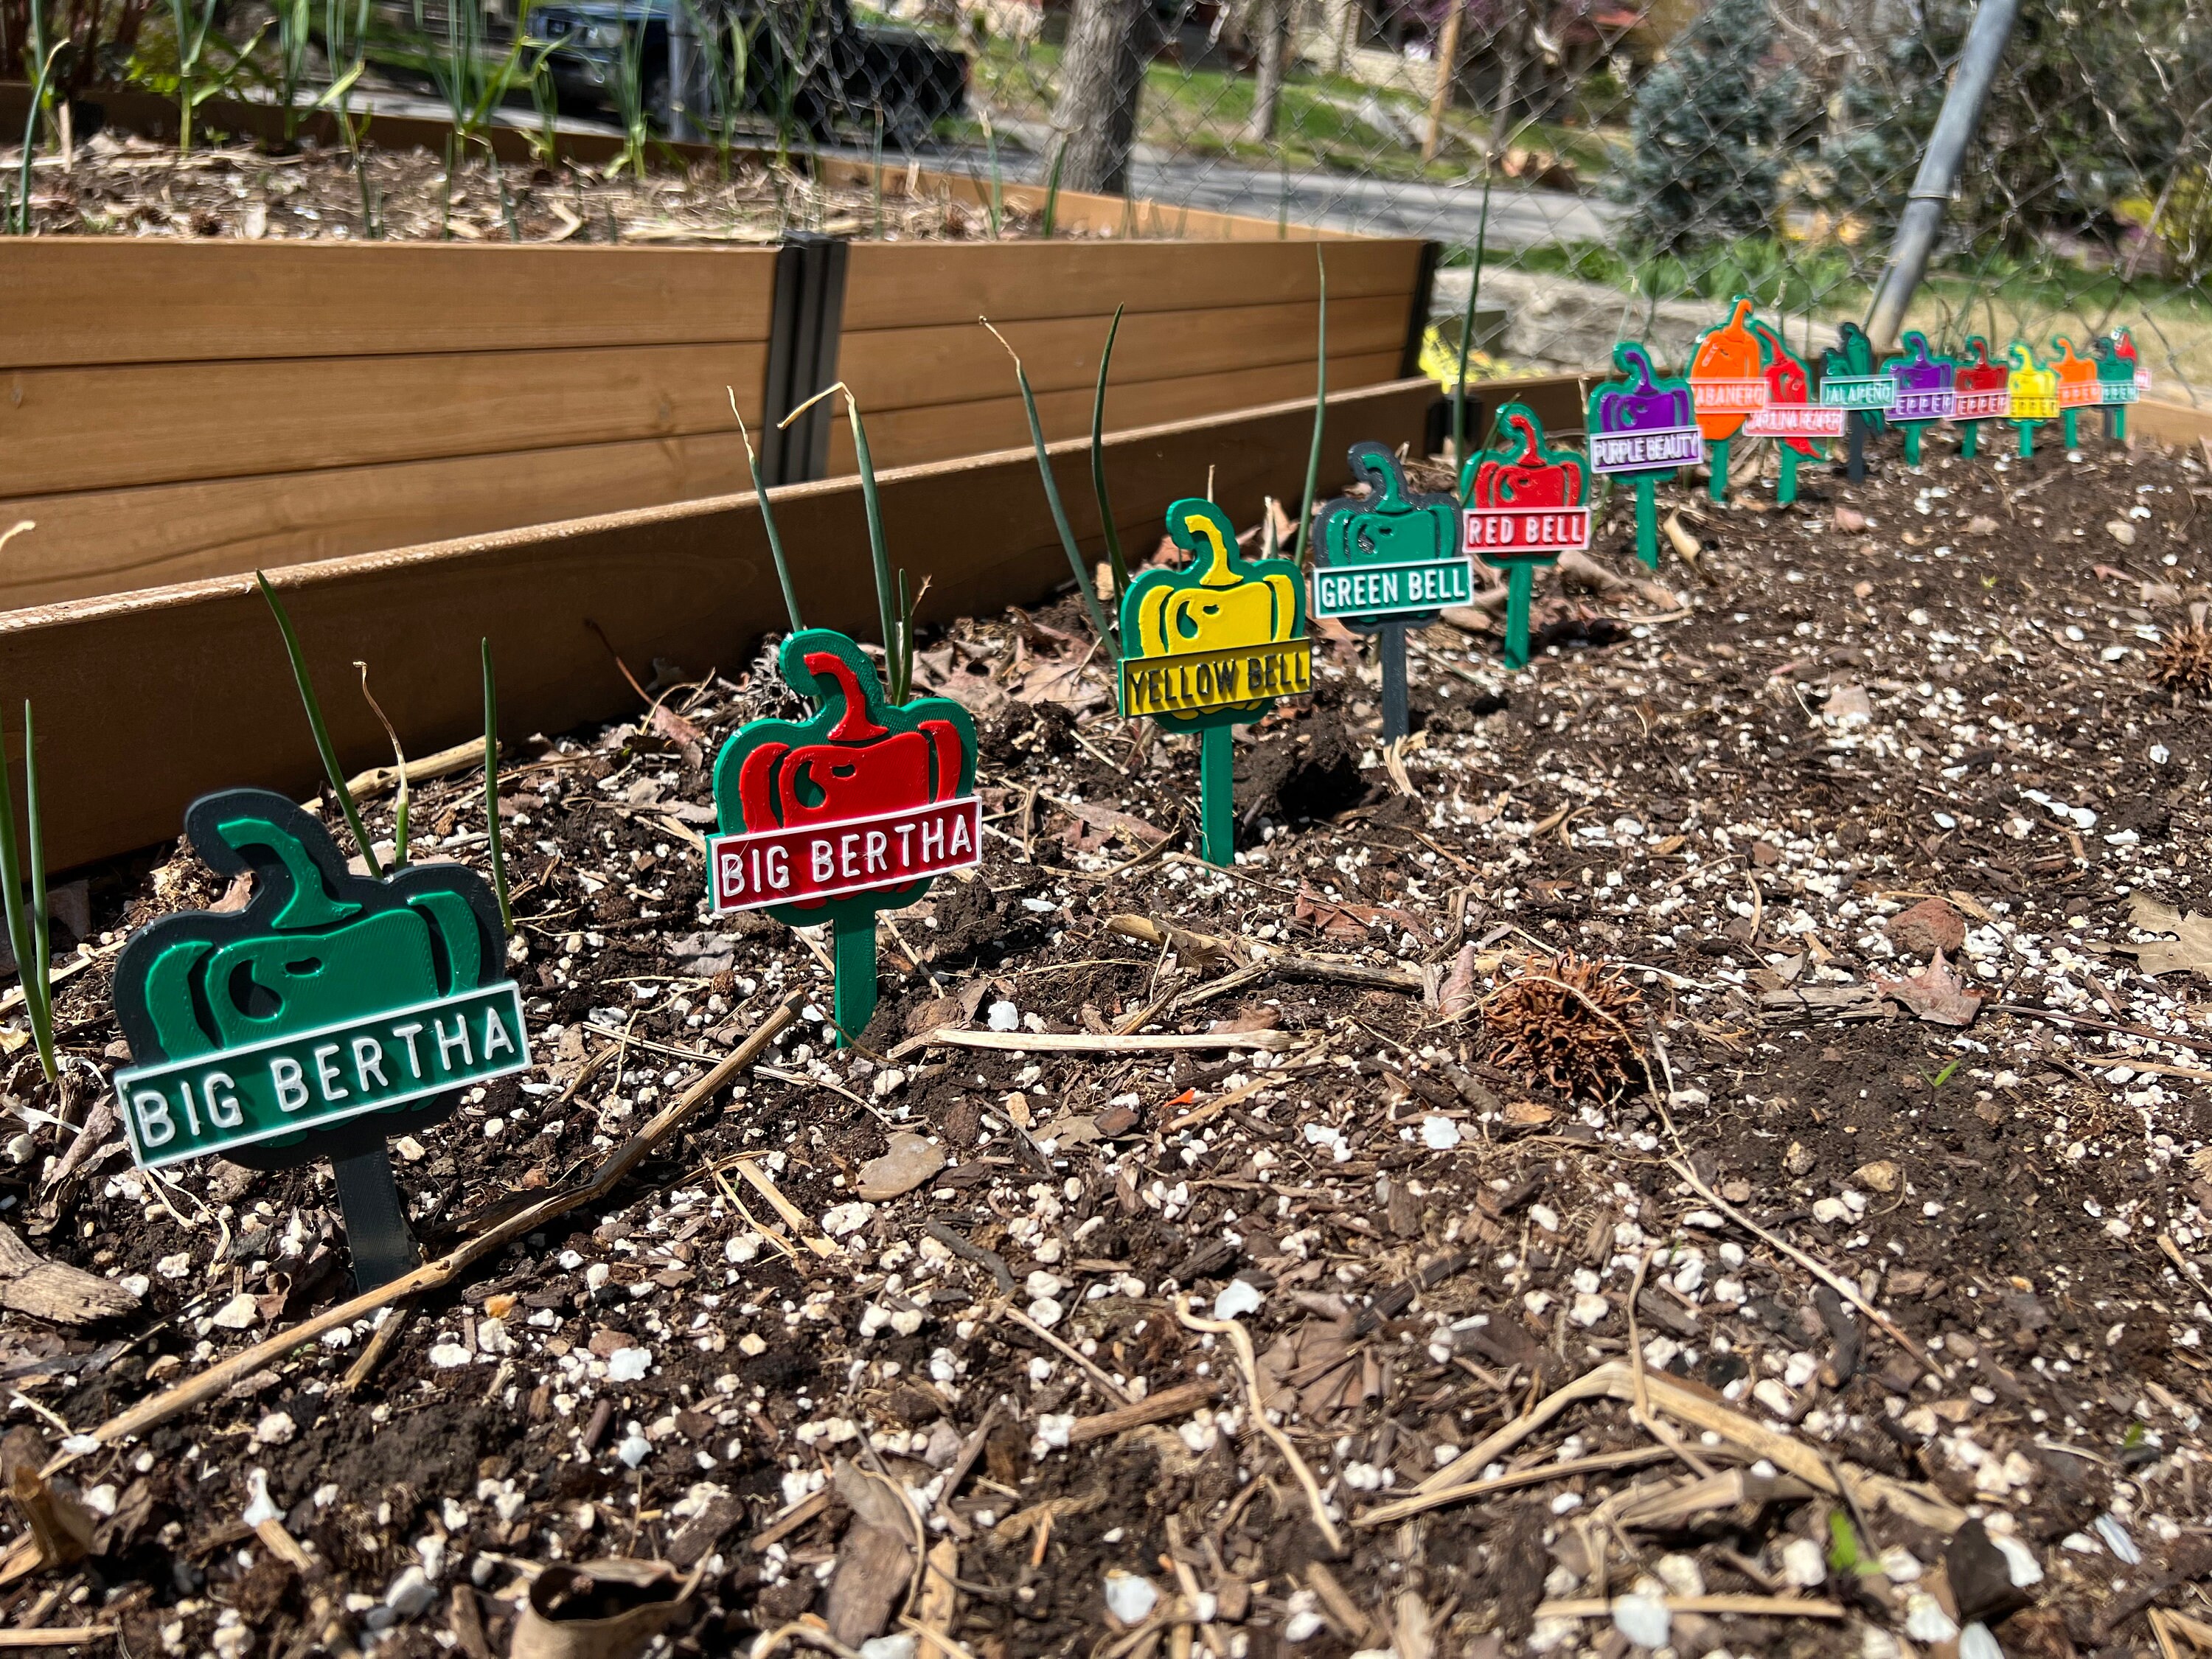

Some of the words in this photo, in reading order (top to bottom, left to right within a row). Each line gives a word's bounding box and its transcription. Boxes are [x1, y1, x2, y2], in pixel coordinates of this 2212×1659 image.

[1694, 385, 1763, 407] ABANERO
[1826, 382, 1891, 405] JALAPEÑO
[1896, 394, 1952, 415] EPPER
[1958, 395, 2006, 415] EPPER
[1593, 437, 1645, 467] PURPLE
[1647, 433, 1697, 461] BEAUTY
[1468, 517, 1514, 544] RED
[1525, 515, 1583, 543] BELL
[1321, 573, 1398, 608] GREEN
[1408, 568, 1467, 601] BELL
[1128, 658, 1237, 706] YELLOW
[1248, 651, 1307, 690] BELL
[721, 845, 790, 897] BIG
[811, 814, 972, 883] BERTHA
[133, 1072, 244, 1147] BIG
[270, 1007, 515, 1113] BERTHA
